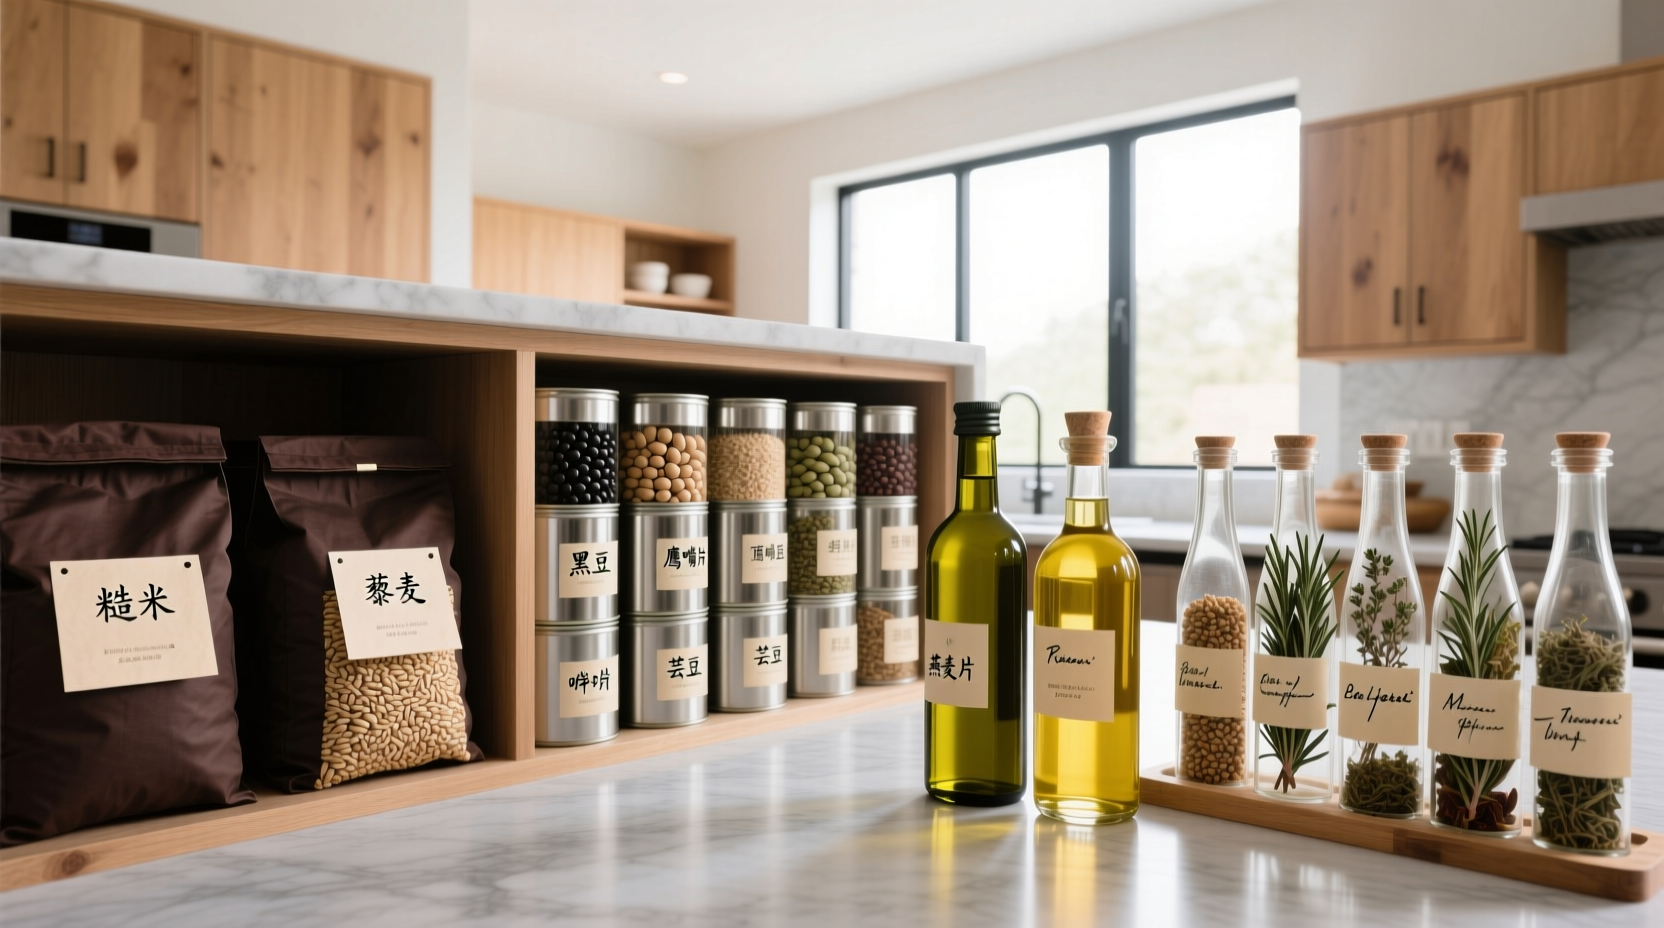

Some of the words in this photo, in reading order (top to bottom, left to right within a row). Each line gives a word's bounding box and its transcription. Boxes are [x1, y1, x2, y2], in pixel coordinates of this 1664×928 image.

[569, 550, 612, 577] 黑豆
[95, 583, 176, 624] 糙米
[365, 572, 427, 607] 藜麦
[666, 656, 703, 680] 芸豆
[753, 645, 783, 666] 芸豆
[928, 653, 975, 682] 燕麦片
